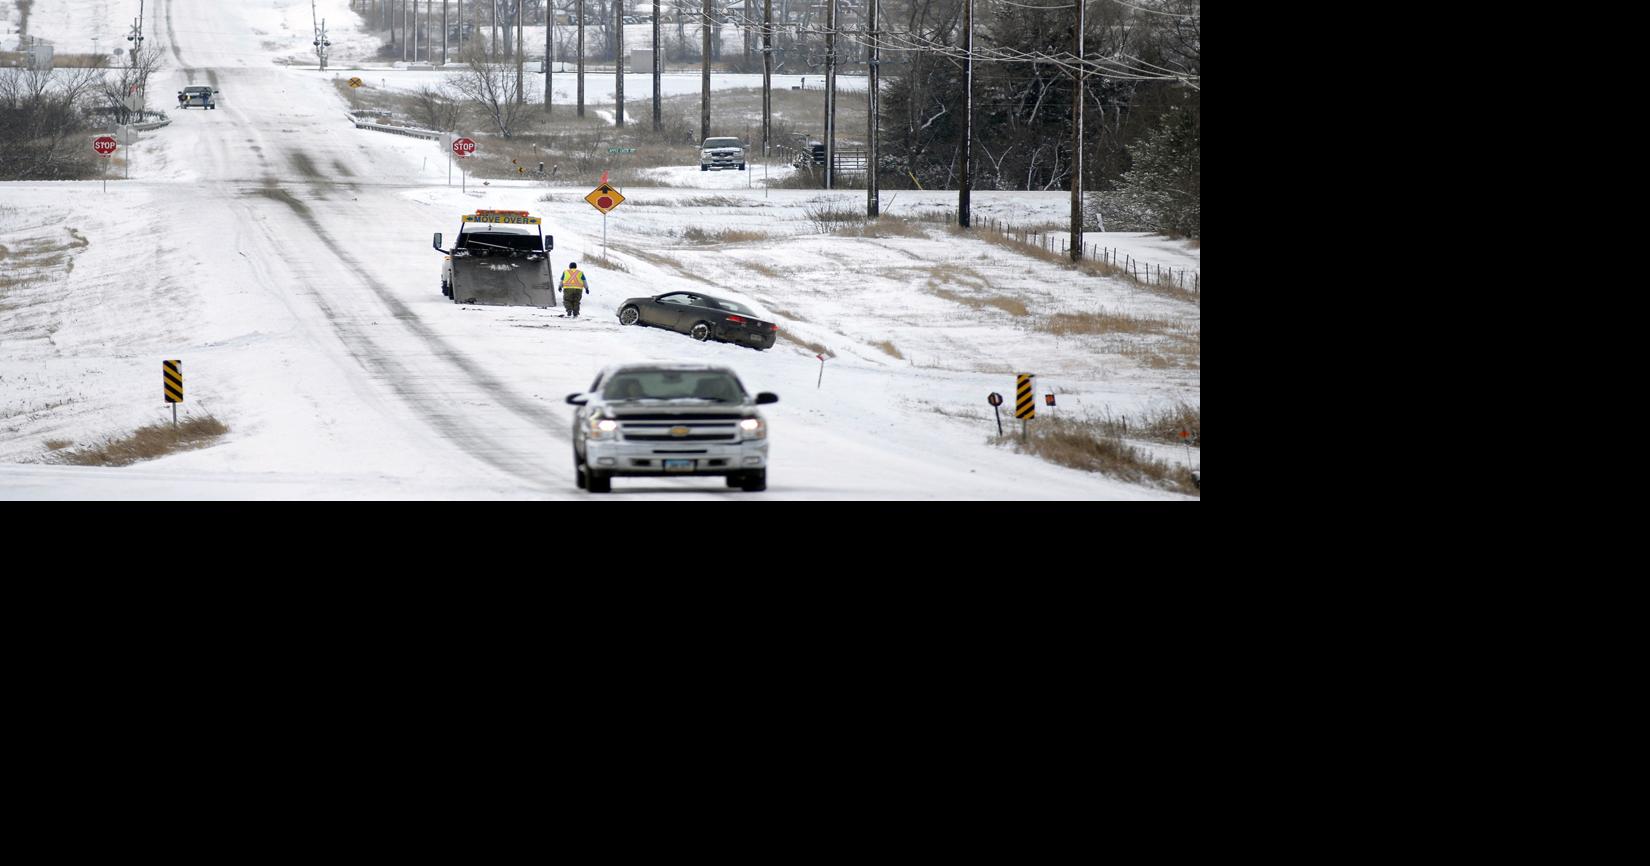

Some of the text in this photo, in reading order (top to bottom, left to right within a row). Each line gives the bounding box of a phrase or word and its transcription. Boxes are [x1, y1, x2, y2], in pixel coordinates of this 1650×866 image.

[95, 141, 115, 149] STOP
[454, 143, 473, 151] STOP
[504, 216, 529, 224] OVER
